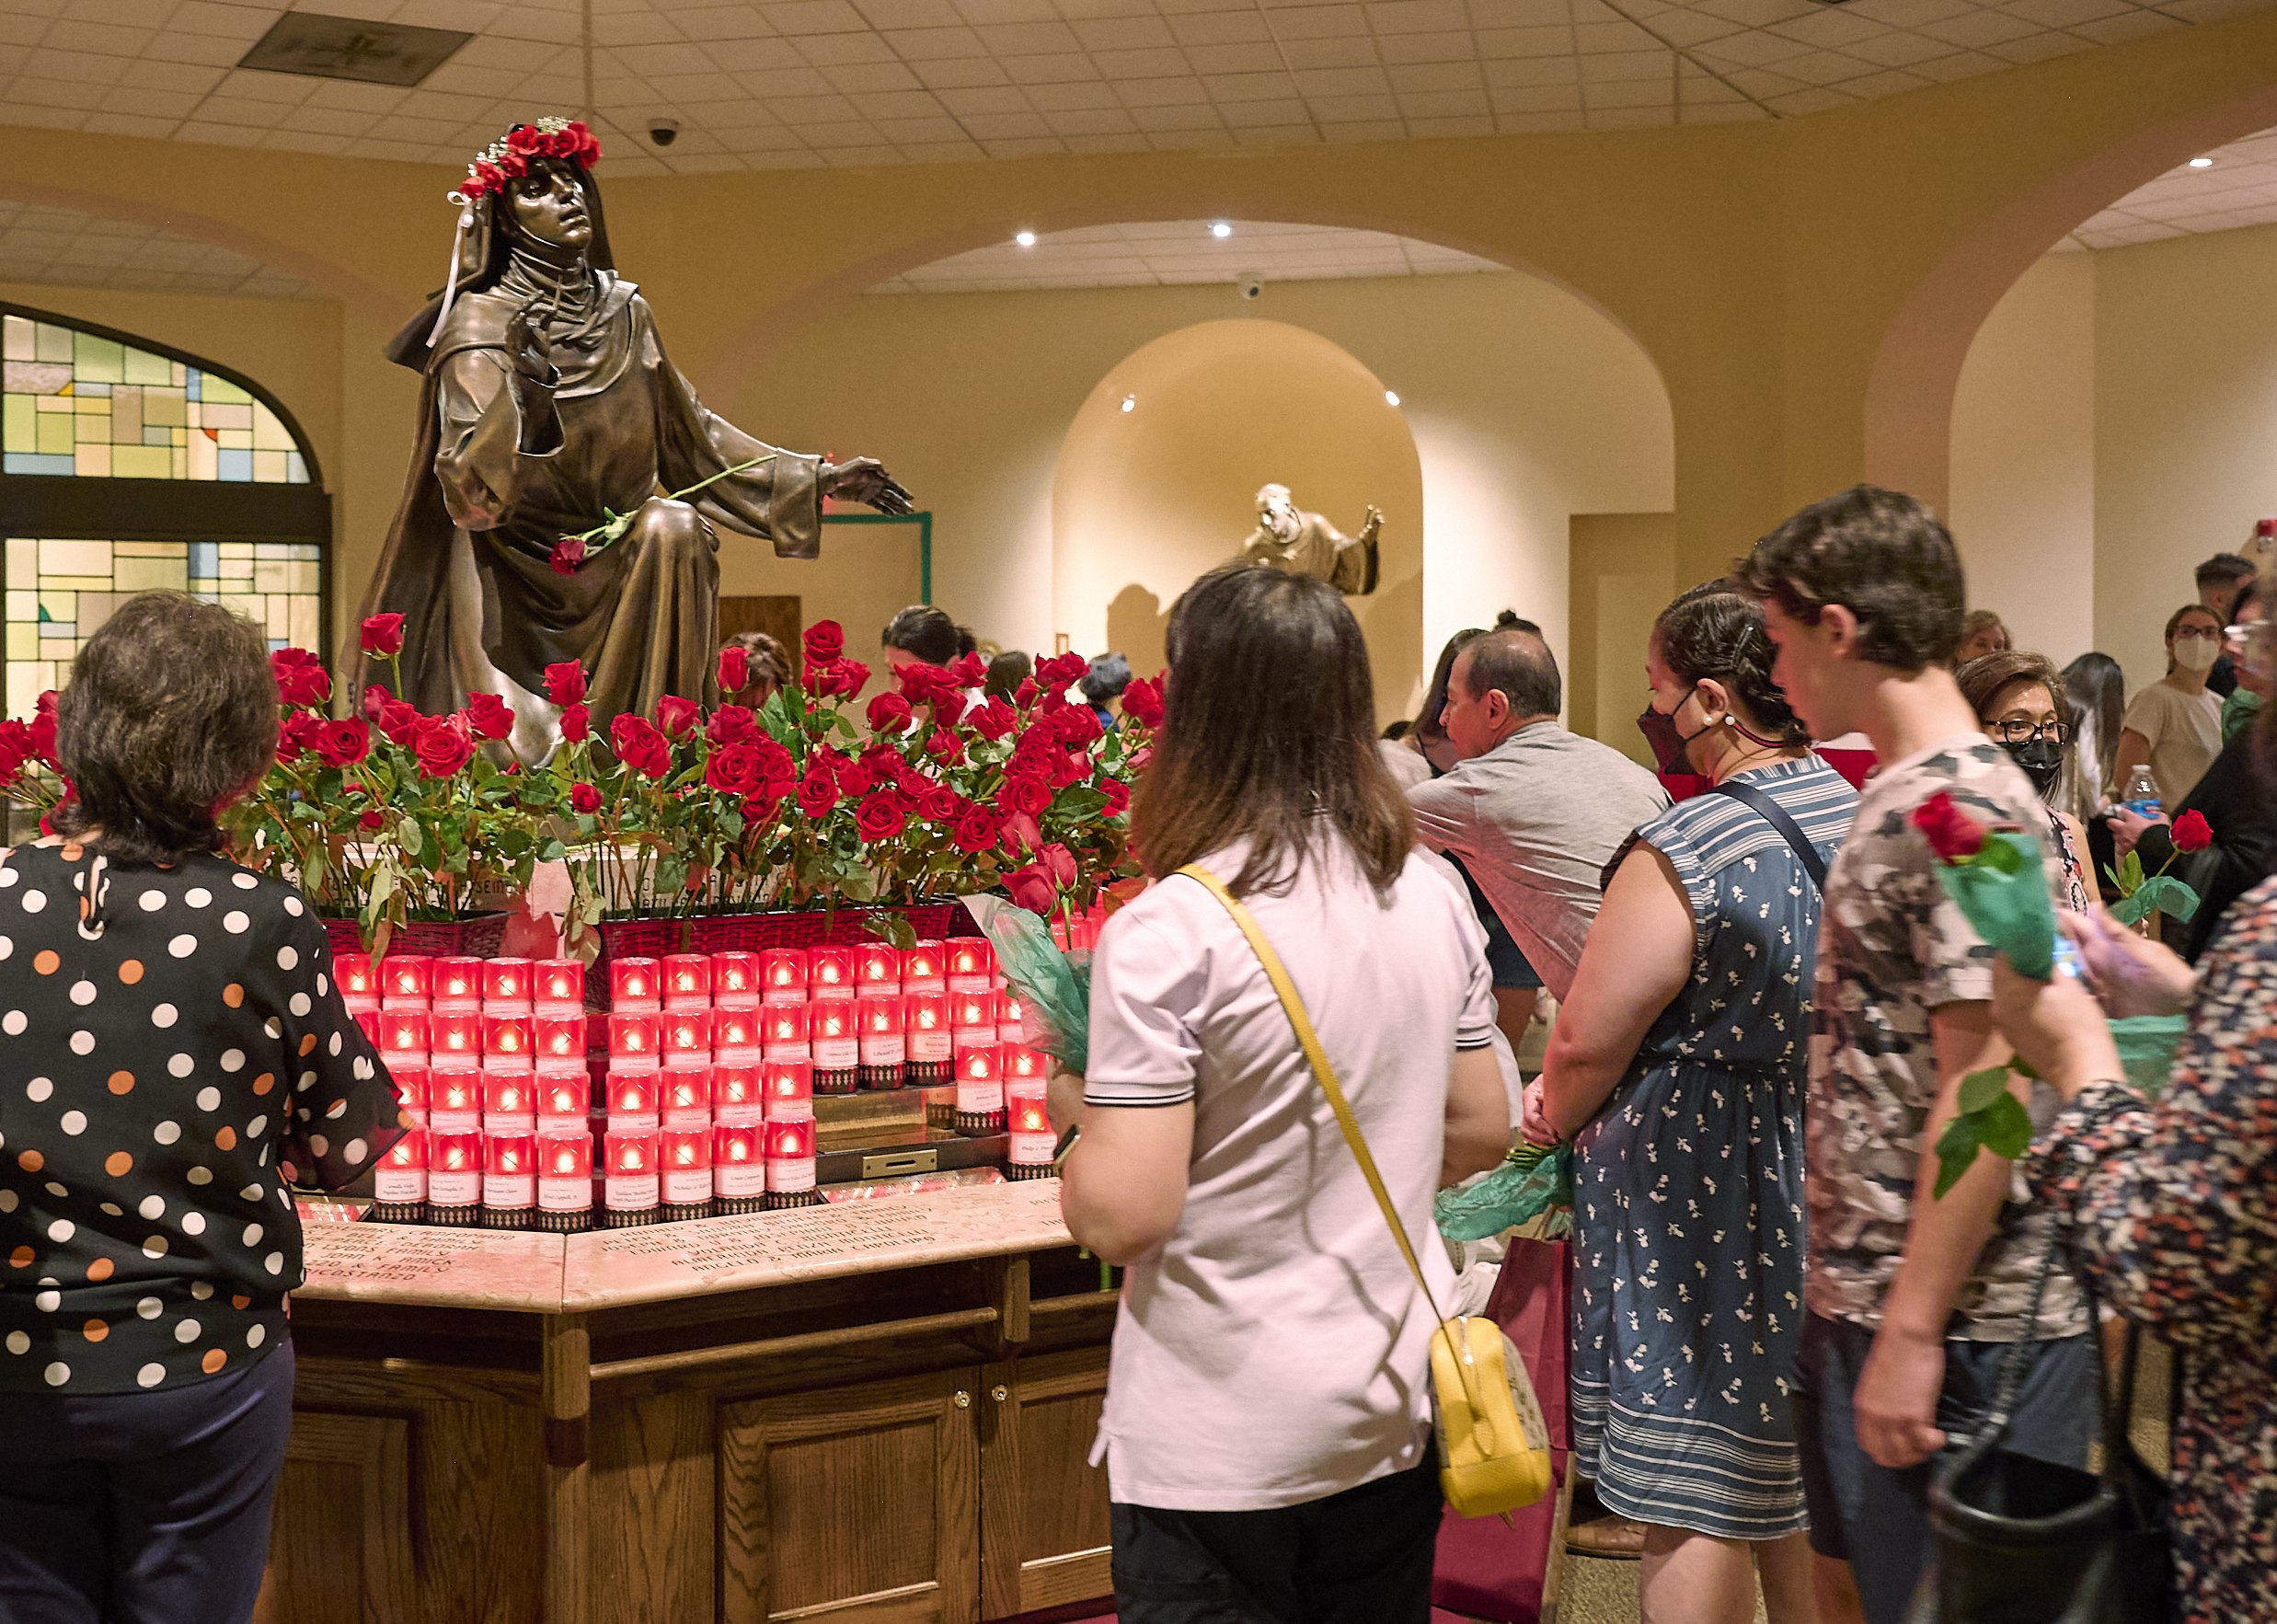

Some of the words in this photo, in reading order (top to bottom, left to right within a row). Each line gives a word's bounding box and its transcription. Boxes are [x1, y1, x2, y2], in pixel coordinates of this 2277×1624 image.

[311, 1225, 400, 1233] ROSEMARY
[400, 1241, 479, 1250] DEBORAH
[420, 1237, 485, 1245] FAMILY
[322, 1244, 379, 1252] LYONS
[385, 1248, 450, 1256] FAMILY
[321, 1252, 366, 1261] JOAN
[399, 1257, 456, 1265] AMICK
[377, 1264, 449, 1273] FAMILY
[692, 1259, 760, 1272] ANGELO
